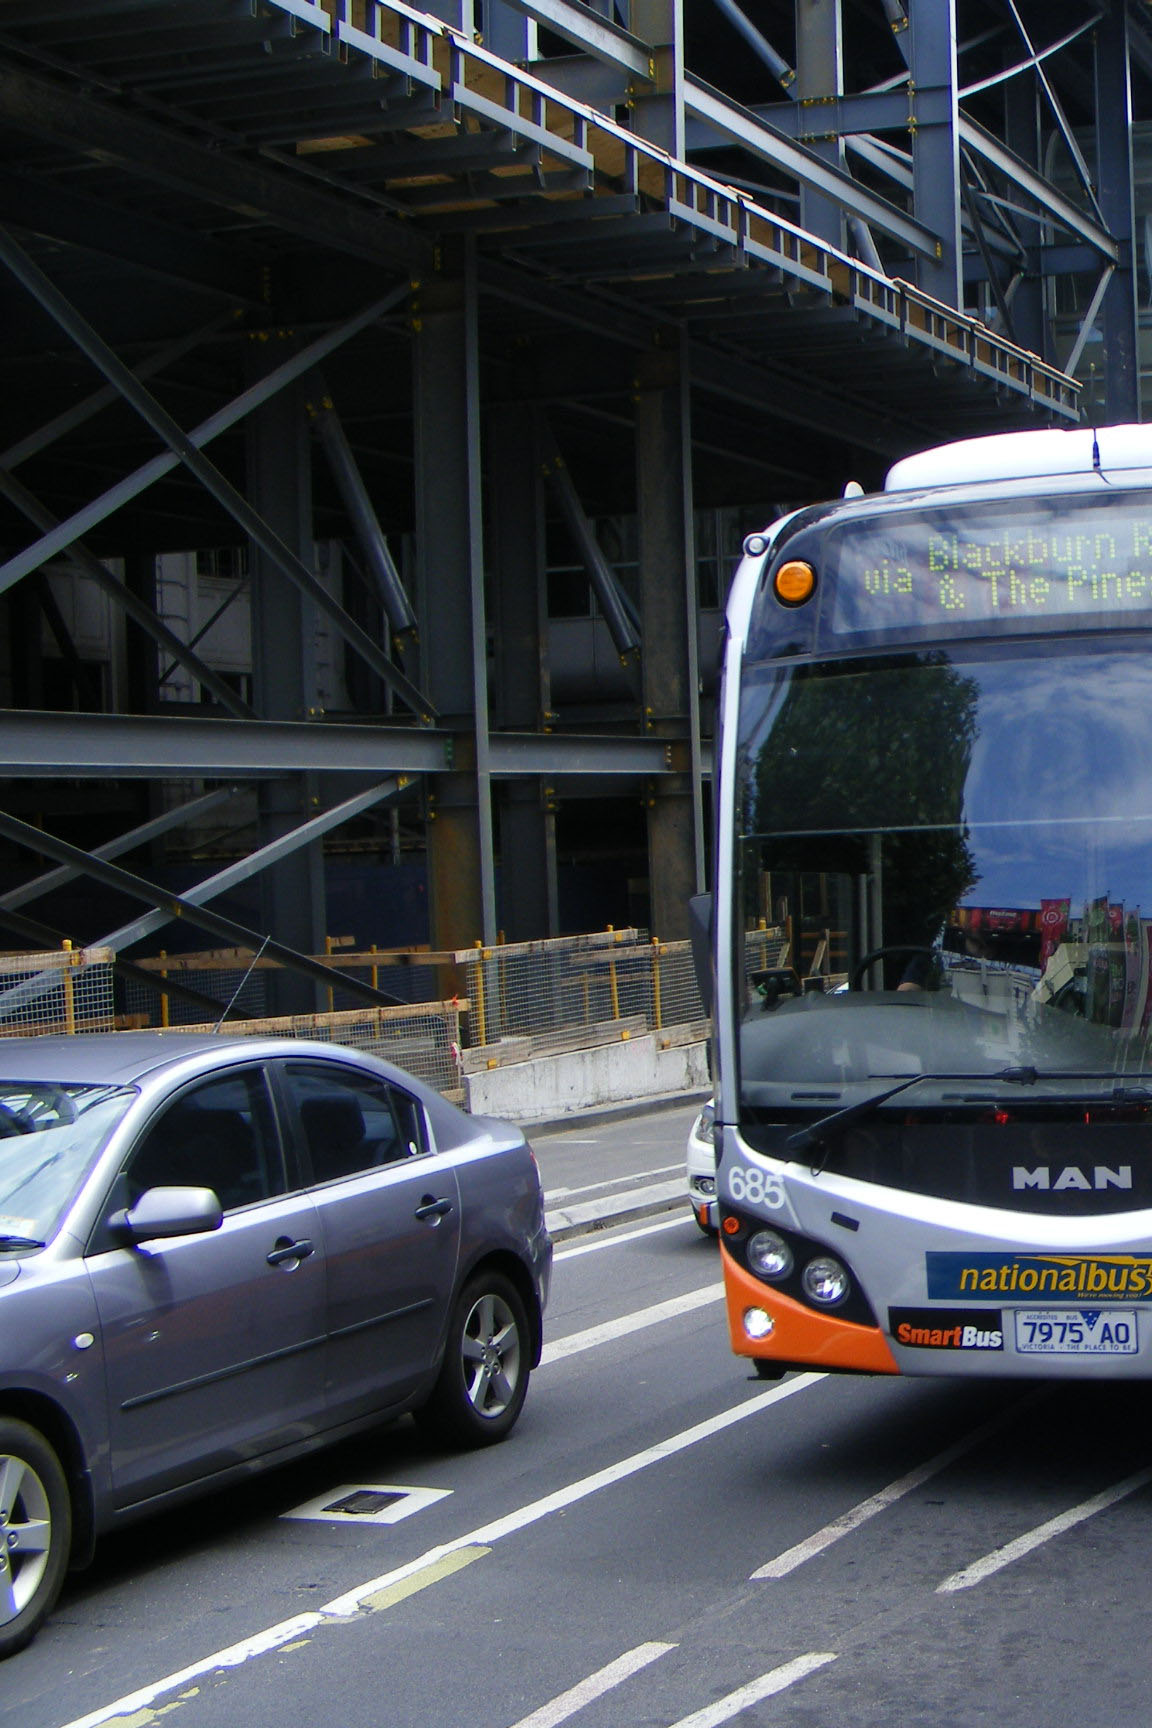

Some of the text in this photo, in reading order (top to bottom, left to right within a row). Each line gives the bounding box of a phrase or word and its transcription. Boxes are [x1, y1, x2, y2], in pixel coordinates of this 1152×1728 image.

[928, 530, 1116, 573] Blackburn
[864, 558, 913, 596] via
[939, 574, 965, 610] &
[982, 569, 1050, 607] The
[728, 1166, 785, 1210] 685
[1012, 1165, 1133, 1190] MAN
[960, 1262, 1147, 1292] nationalbus
[897, 1322, 1003, 1348] SmartBus
[1023, 1321, 1084, 1344] 7975
